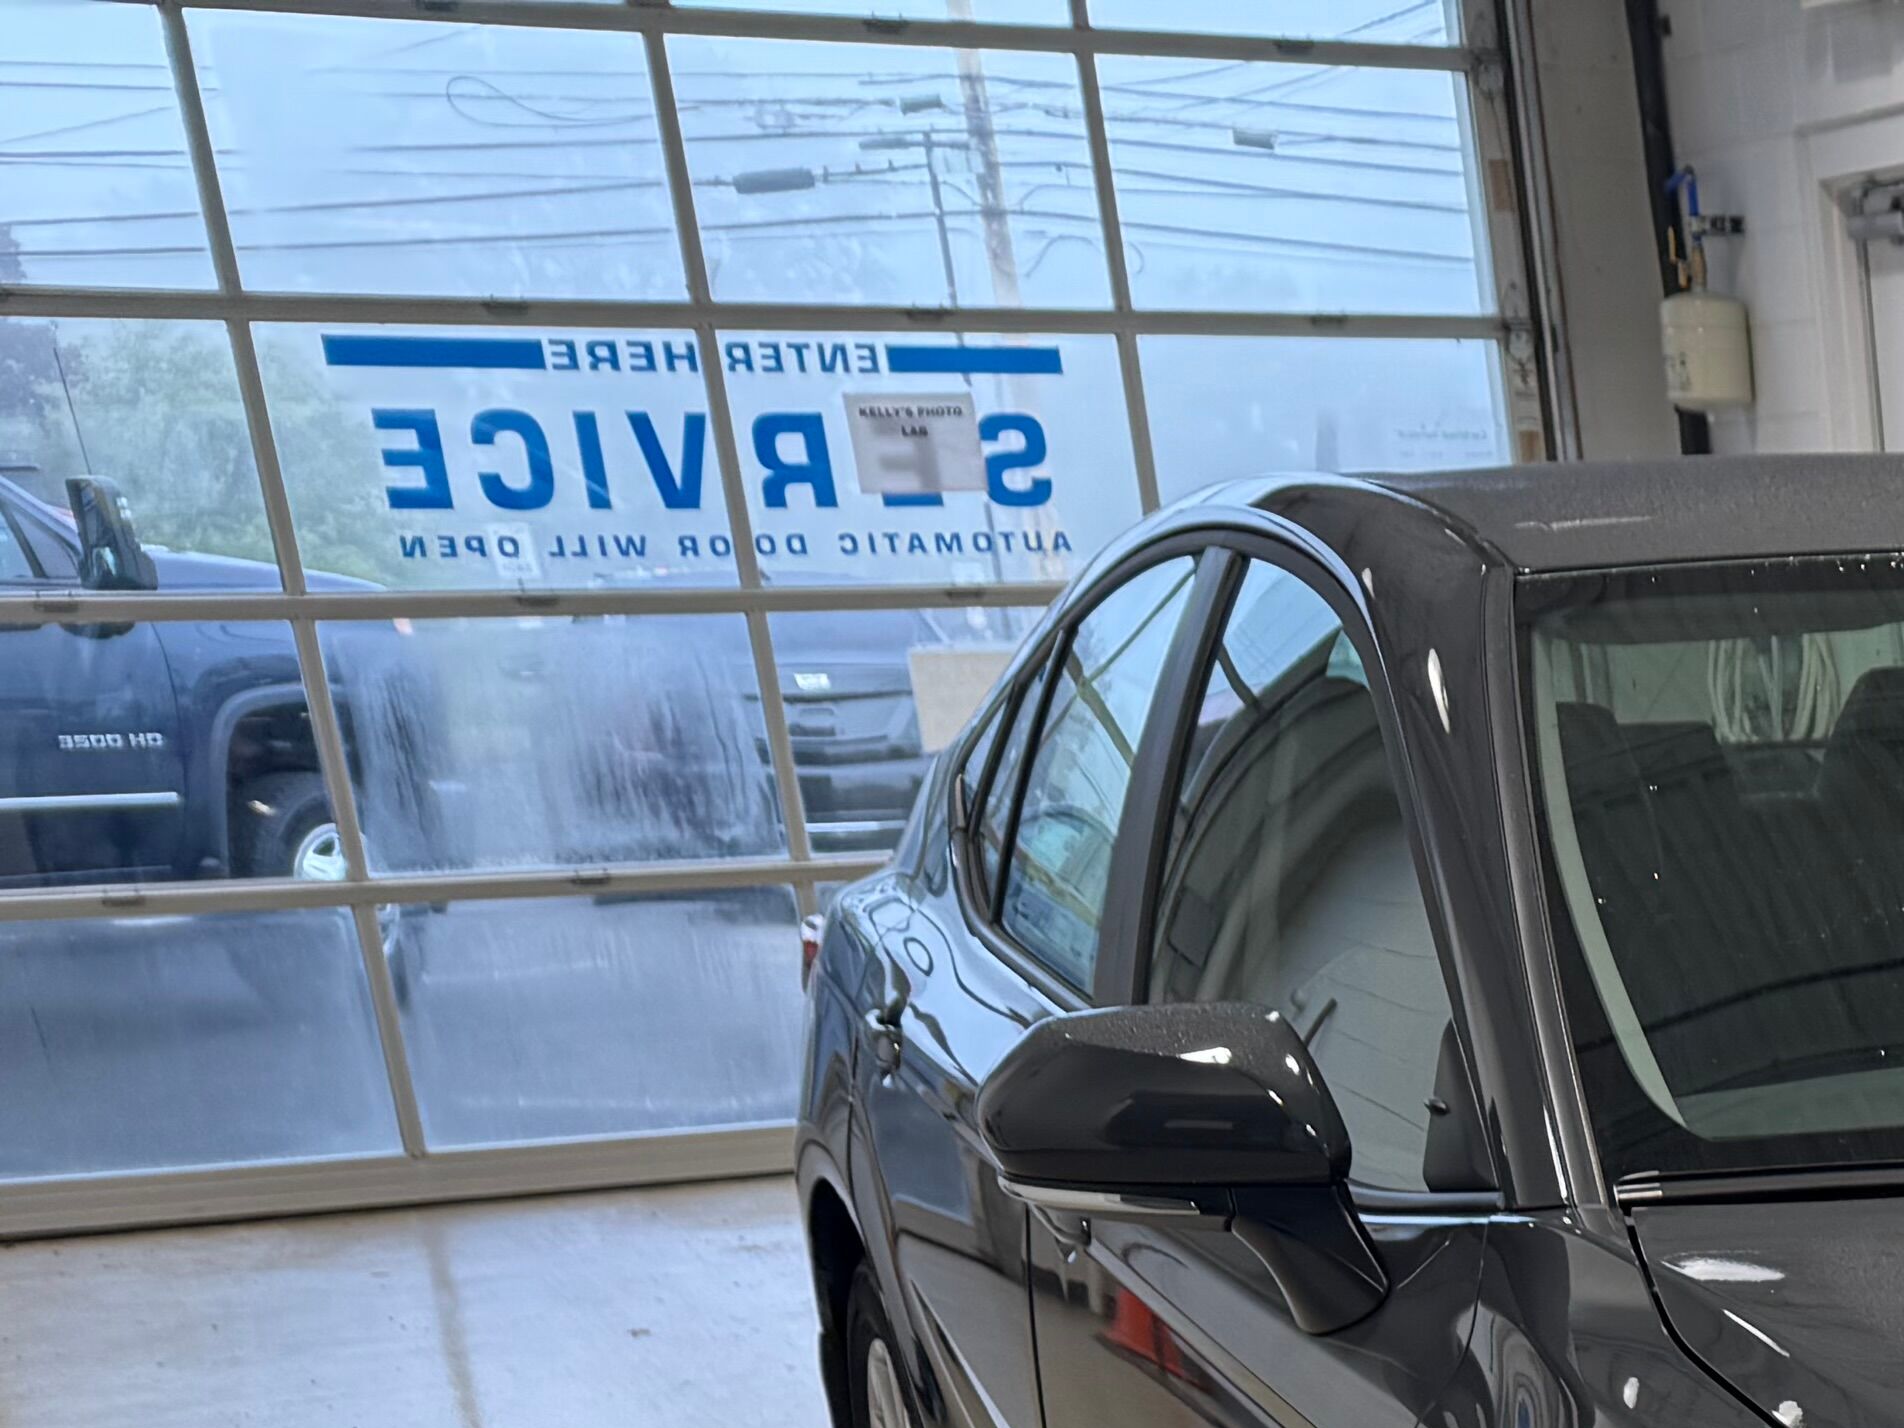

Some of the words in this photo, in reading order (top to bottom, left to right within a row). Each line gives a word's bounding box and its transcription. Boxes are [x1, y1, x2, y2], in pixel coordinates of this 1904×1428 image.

[917, 406, 963, 418] PHOTO
[901, 425, 929, 438] LAB
[129, 732, 164, 748] HD
